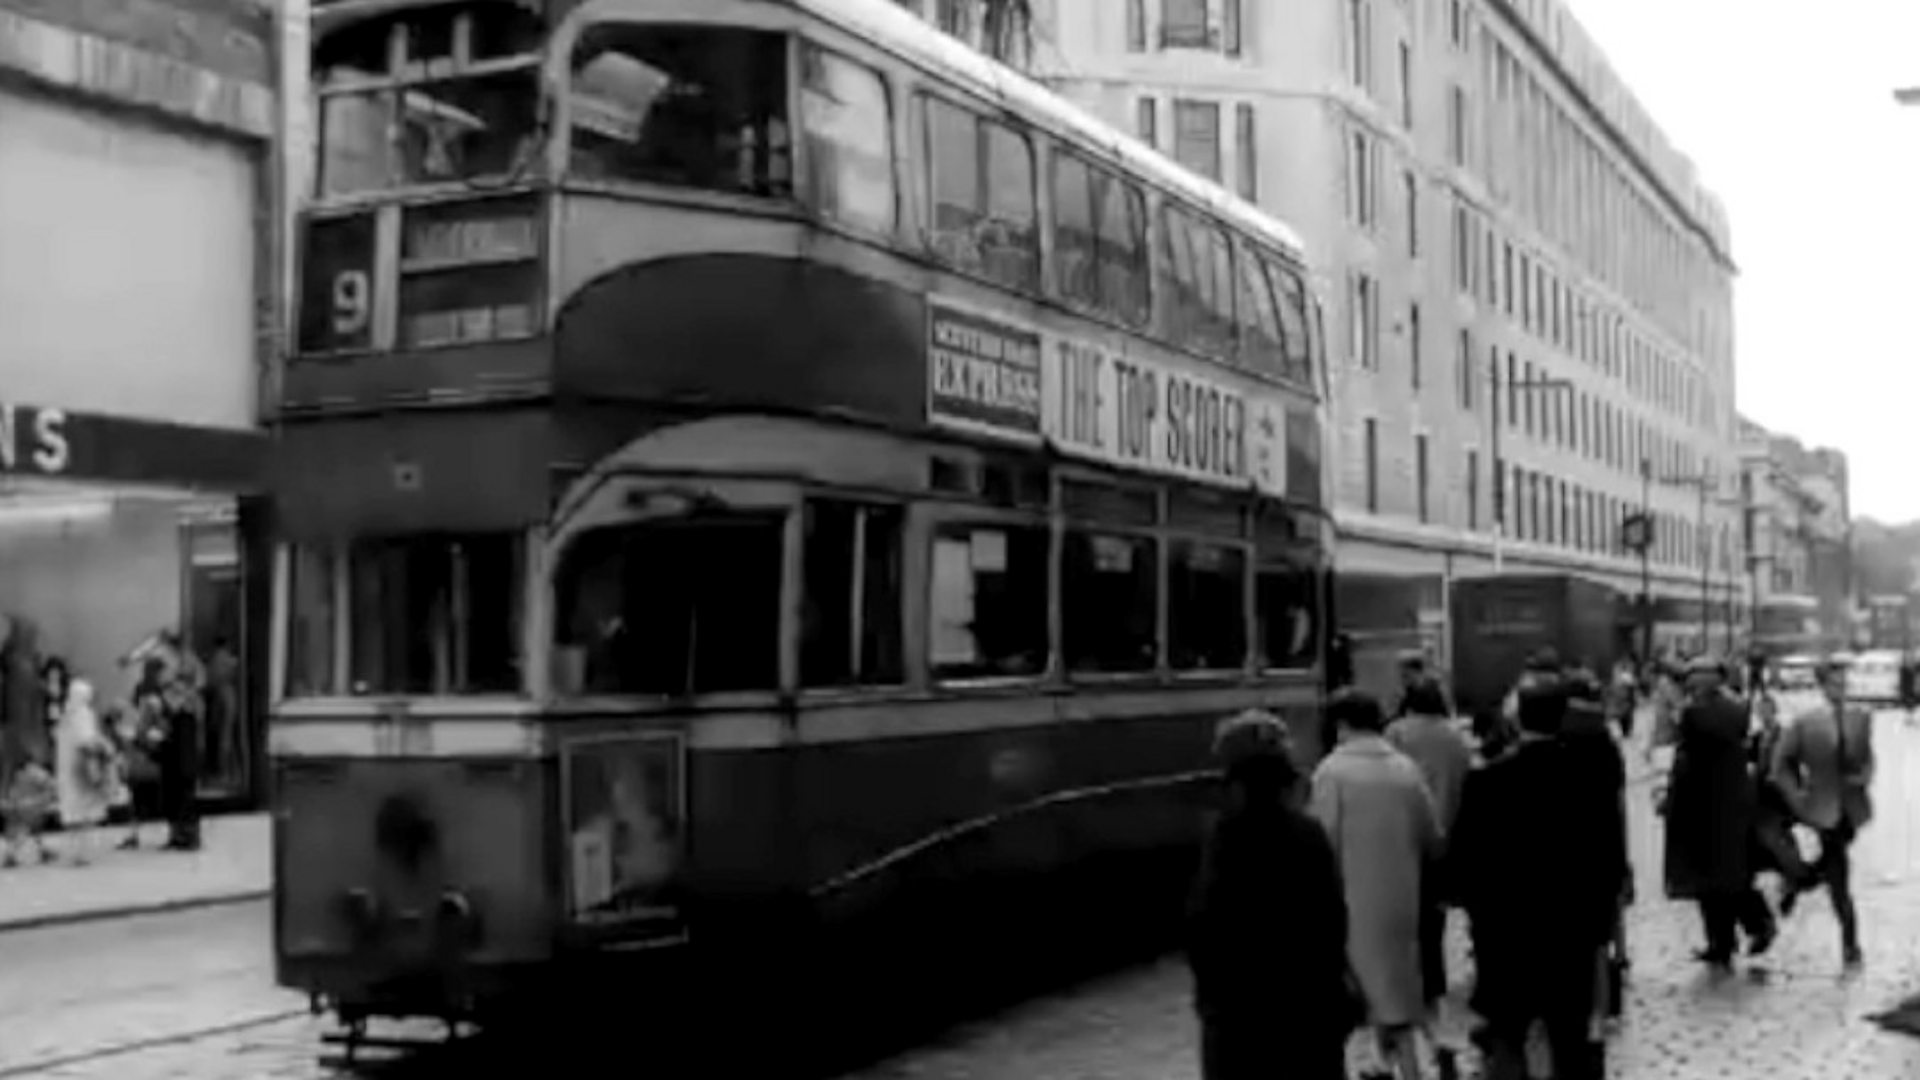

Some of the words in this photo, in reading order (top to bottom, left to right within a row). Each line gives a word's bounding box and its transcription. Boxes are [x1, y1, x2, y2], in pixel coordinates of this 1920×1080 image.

[333, 269, 368, 334] 9
[934, 352, 1040, 416] EXPRESS
[1057, 340, 1105, 447] THE
[1113, 357, 1158, 458] TOP
